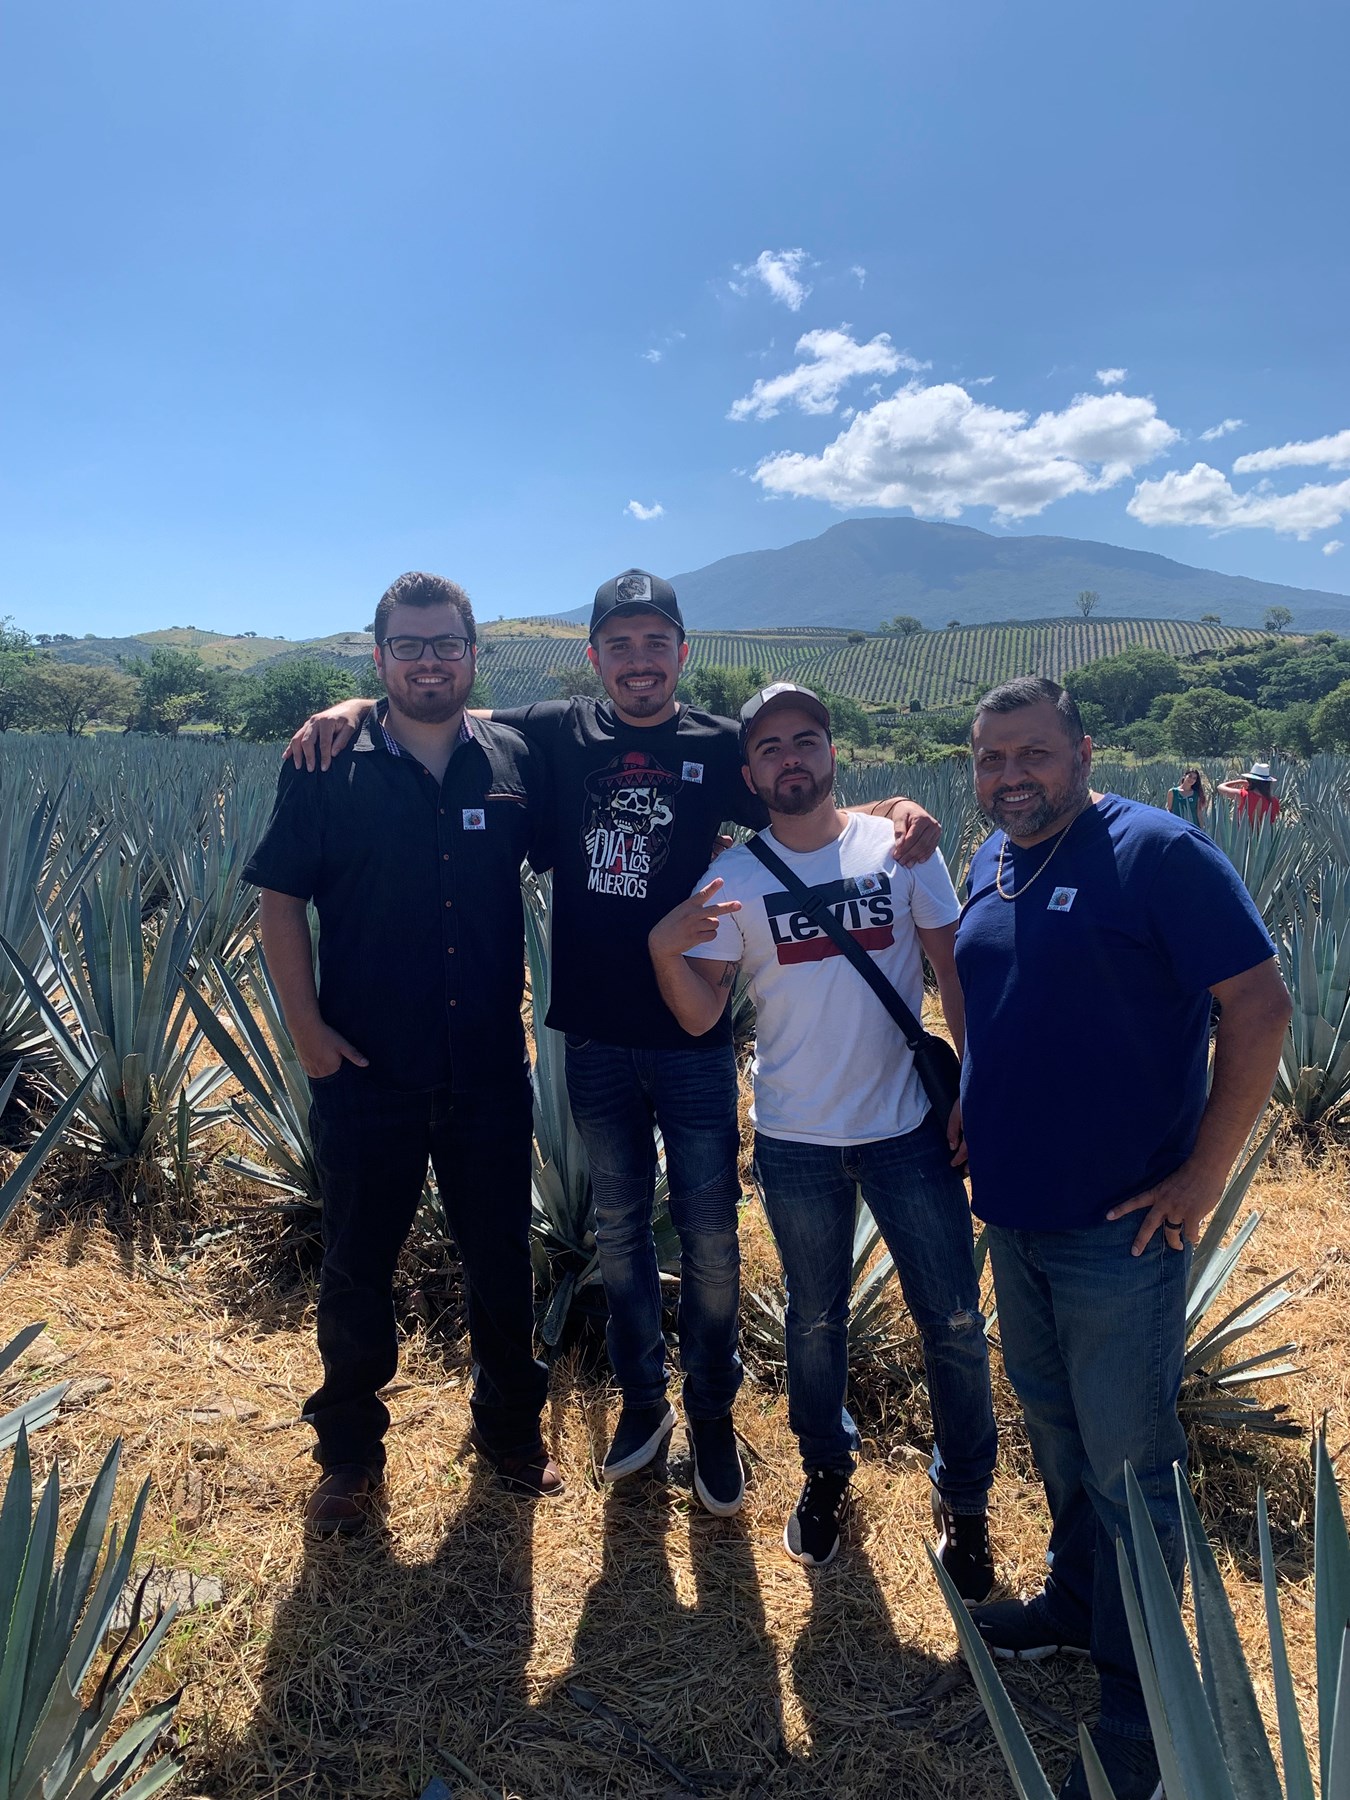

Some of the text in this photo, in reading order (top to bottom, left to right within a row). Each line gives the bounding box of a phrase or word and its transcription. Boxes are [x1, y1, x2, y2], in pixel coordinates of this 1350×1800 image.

[632, 834, 648, 854] DE
[629, 852, 650, 873] LOS
[588, 869, 647, 898] MUERTOS
